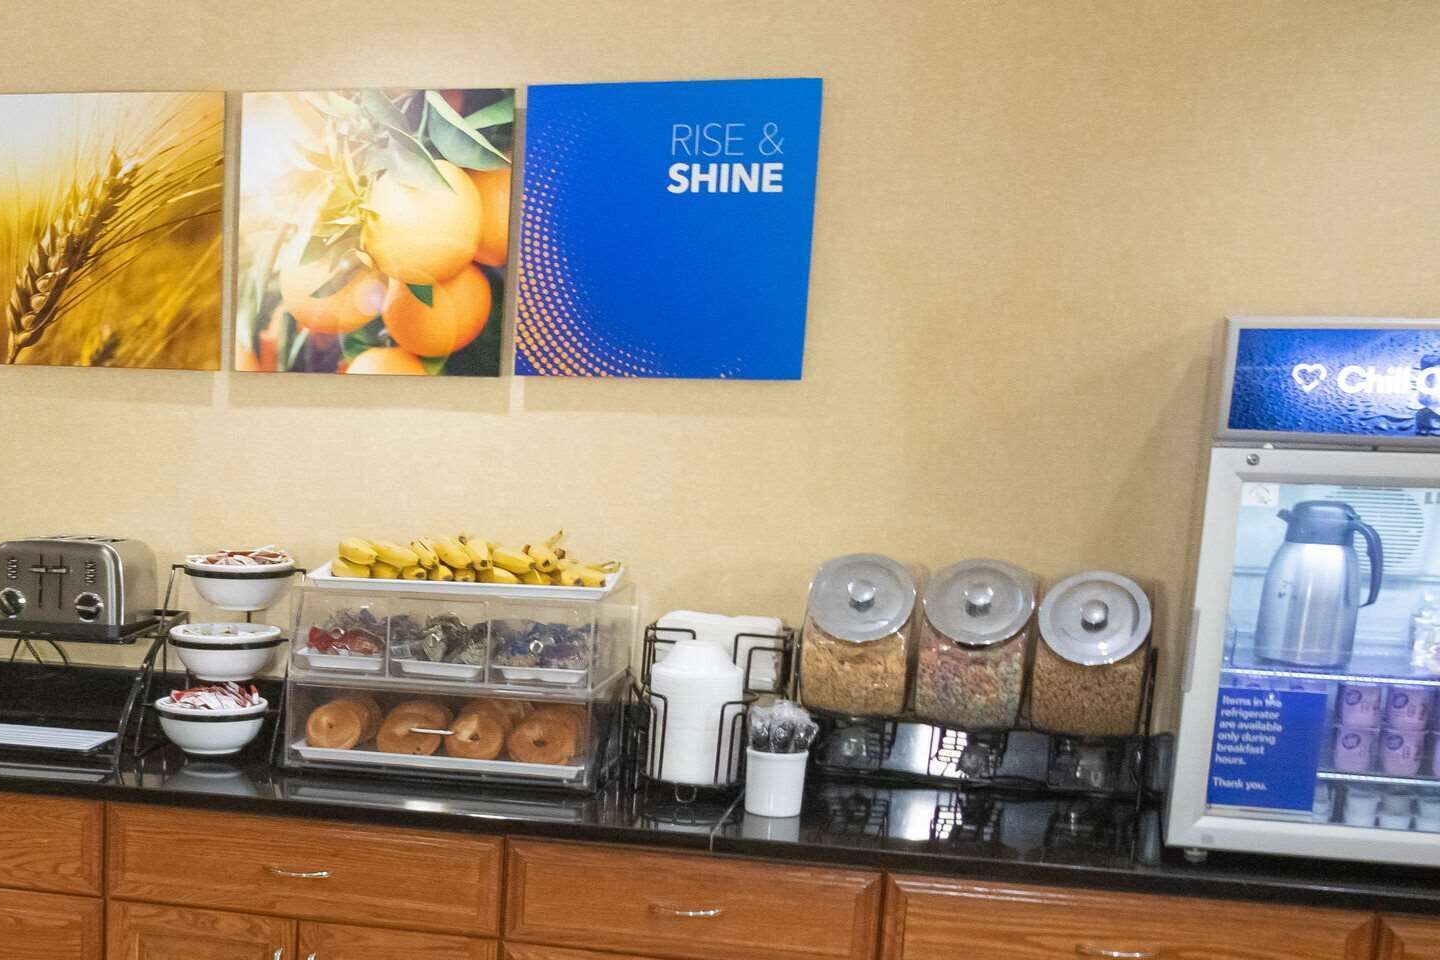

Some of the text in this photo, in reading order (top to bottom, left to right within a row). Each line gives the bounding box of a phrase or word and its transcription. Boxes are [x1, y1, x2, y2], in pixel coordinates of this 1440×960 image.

[672, 122, 785, 156] RISE &
[666, 162, 784, 194] SHINE
[1337, 364, 1410, 394] Chill
[1222, 695, 1252, 706] Items
[1253, 696, 1264, 707] in
[1220, 707, 1280, 720] refrigerator
[1219, 720, 1283, 732] are available
[1217, 731, 1276, 746] only during
[1216, 743, 1264, 754] breakfast
[1215, 754, 1246, 765] hours.
[1213, 777, 1267, 791] Thank you.
